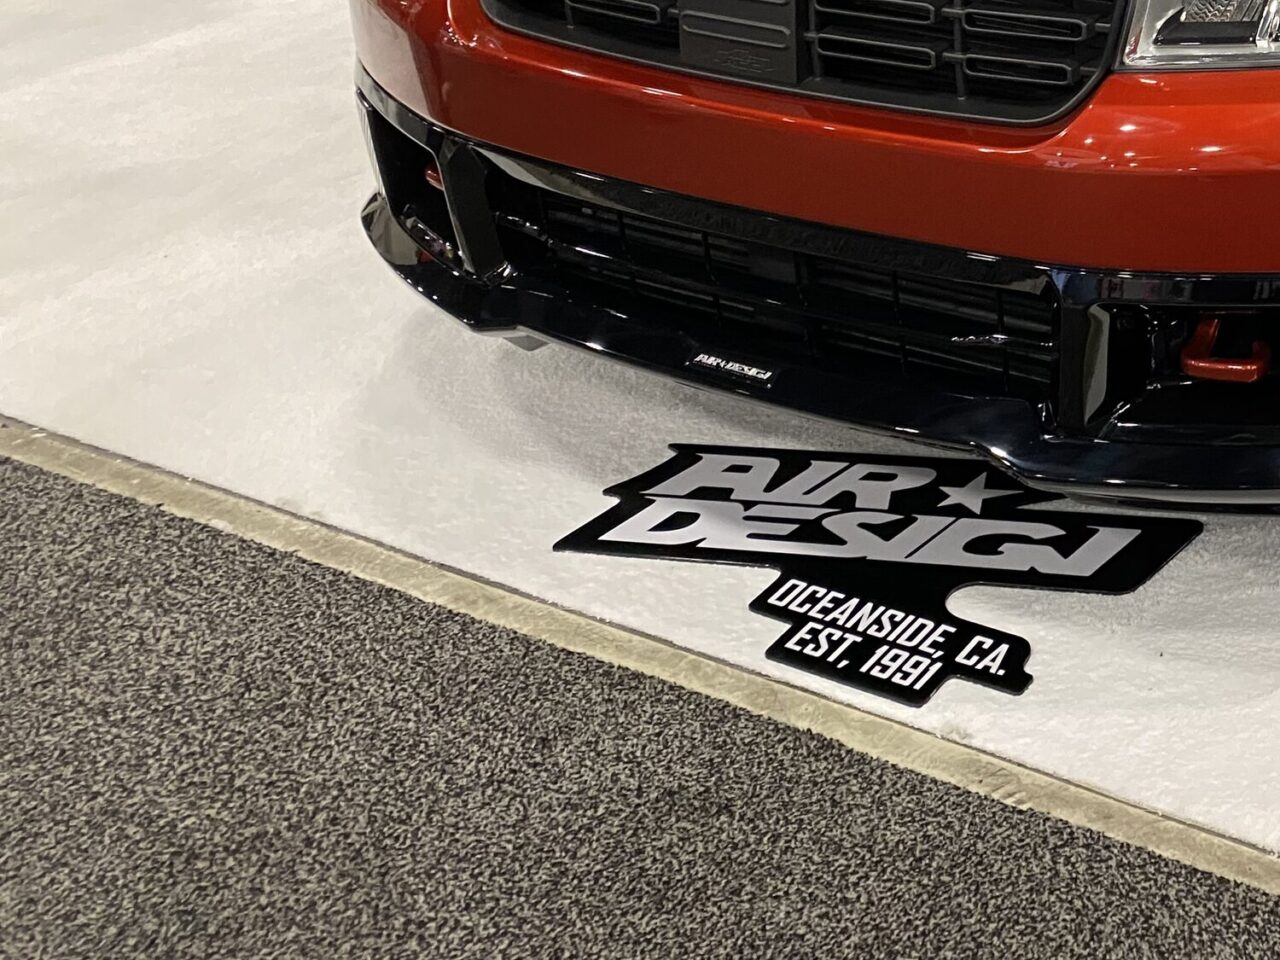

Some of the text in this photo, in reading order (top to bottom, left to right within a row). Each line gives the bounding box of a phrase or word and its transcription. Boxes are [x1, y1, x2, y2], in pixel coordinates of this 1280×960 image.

[639, 453, 937, 511] AIR
[598, 496, 1142, 577] DESIGN
[767, 578, 1010, 676] OCEANSIDE, CA.
[784, 621, 943, 690] EST, 1991
